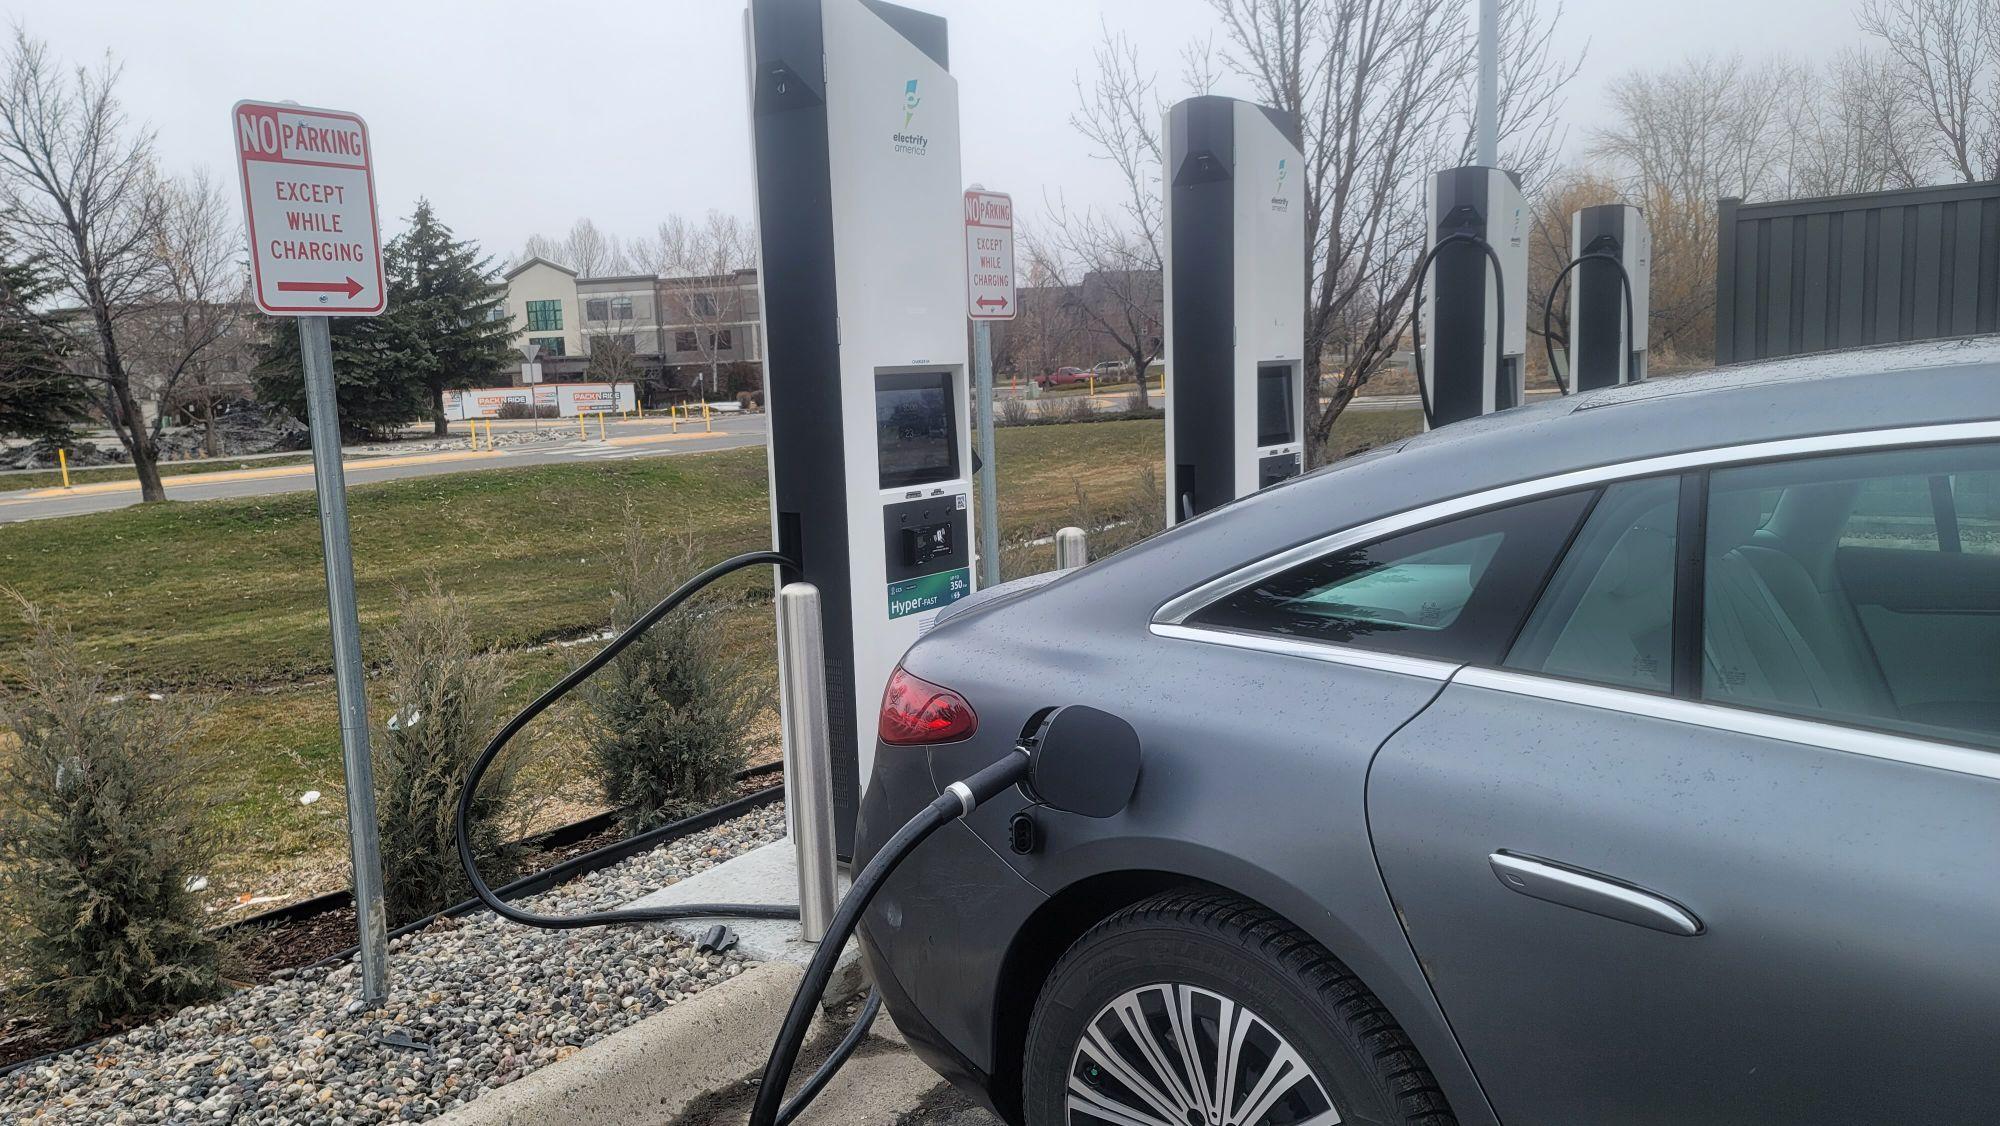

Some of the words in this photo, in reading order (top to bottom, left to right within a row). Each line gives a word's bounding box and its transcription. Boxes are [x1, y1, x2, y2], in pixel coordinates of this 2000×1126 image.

[239, 113, 278, 154] NO
[281, 123, 361, 156] PARKING
[893, 132, 928, 148] electrify
[894, 144, 926, 156] america
[276, 181, 344, 204] EXCEPT
[965, 198, 979, 221] NO
[980, 201, 1010, 221] PARKING
[286, 211, 343, 233] WHILE
[270, 240, 364, 262] CHARGING
[977, 238, 1002, 250] EXCEPT
[981, 257, 1001, 268] WHILE
[974, 274, 1009, 287] CHARGING
[950, 580, 963, 590] 350
